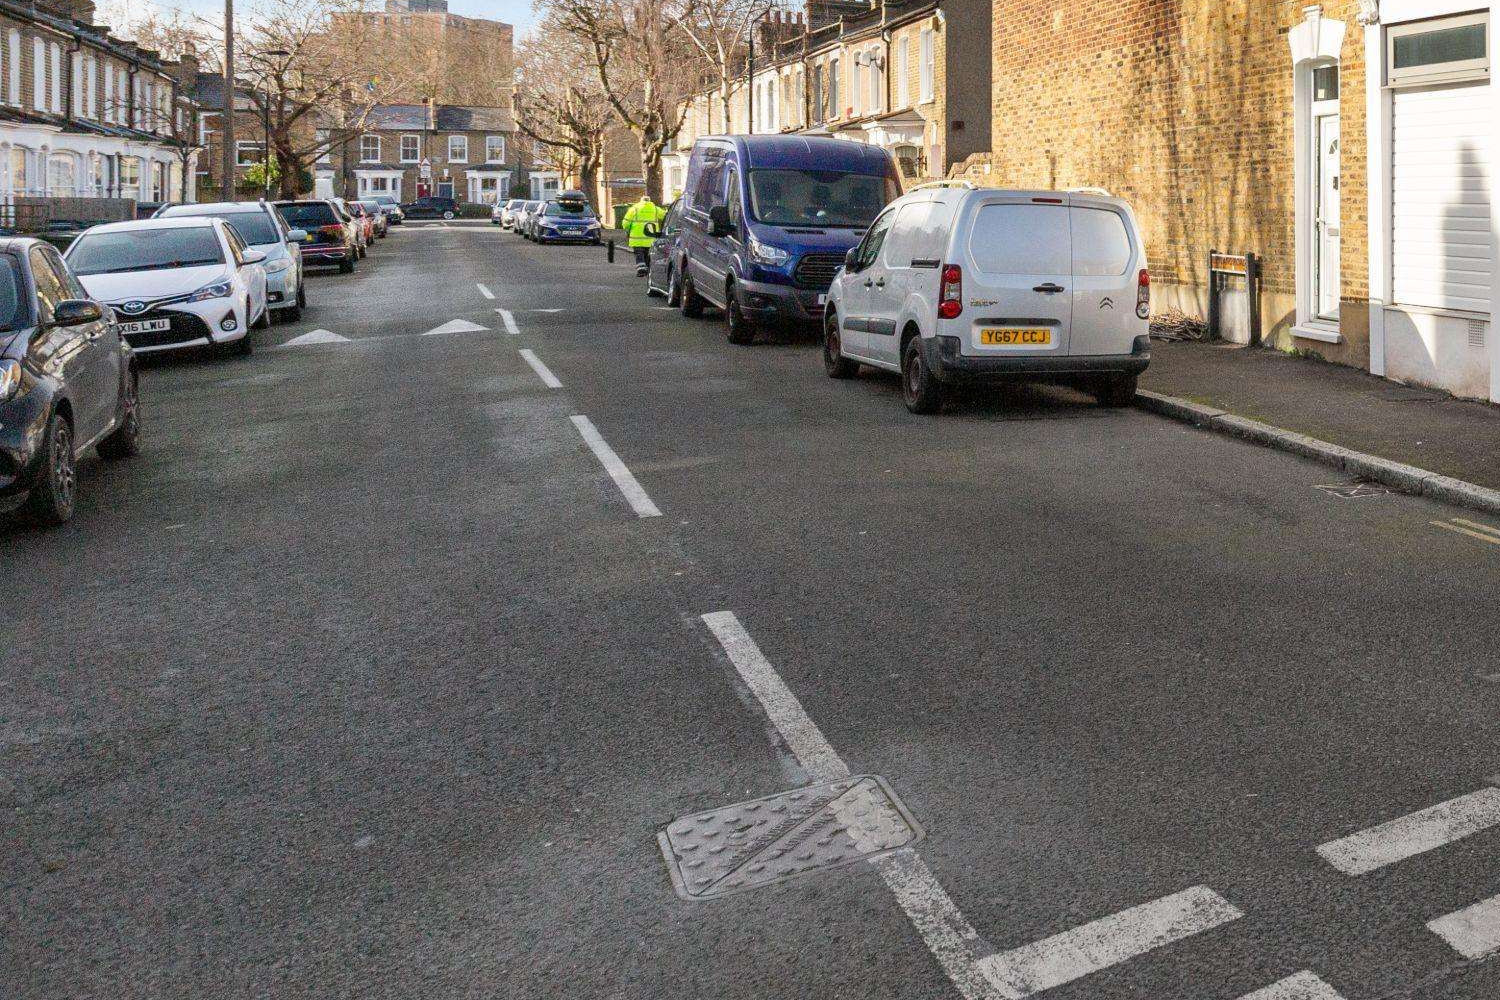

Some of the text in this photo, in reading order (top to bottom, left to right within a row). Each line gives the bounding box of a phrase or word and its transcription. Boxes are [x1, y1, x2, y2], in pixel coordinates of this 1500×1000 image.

[117, 321, 166, 333] X16 LWU
[987, 331, 1046, 343] YG67 CCJ
